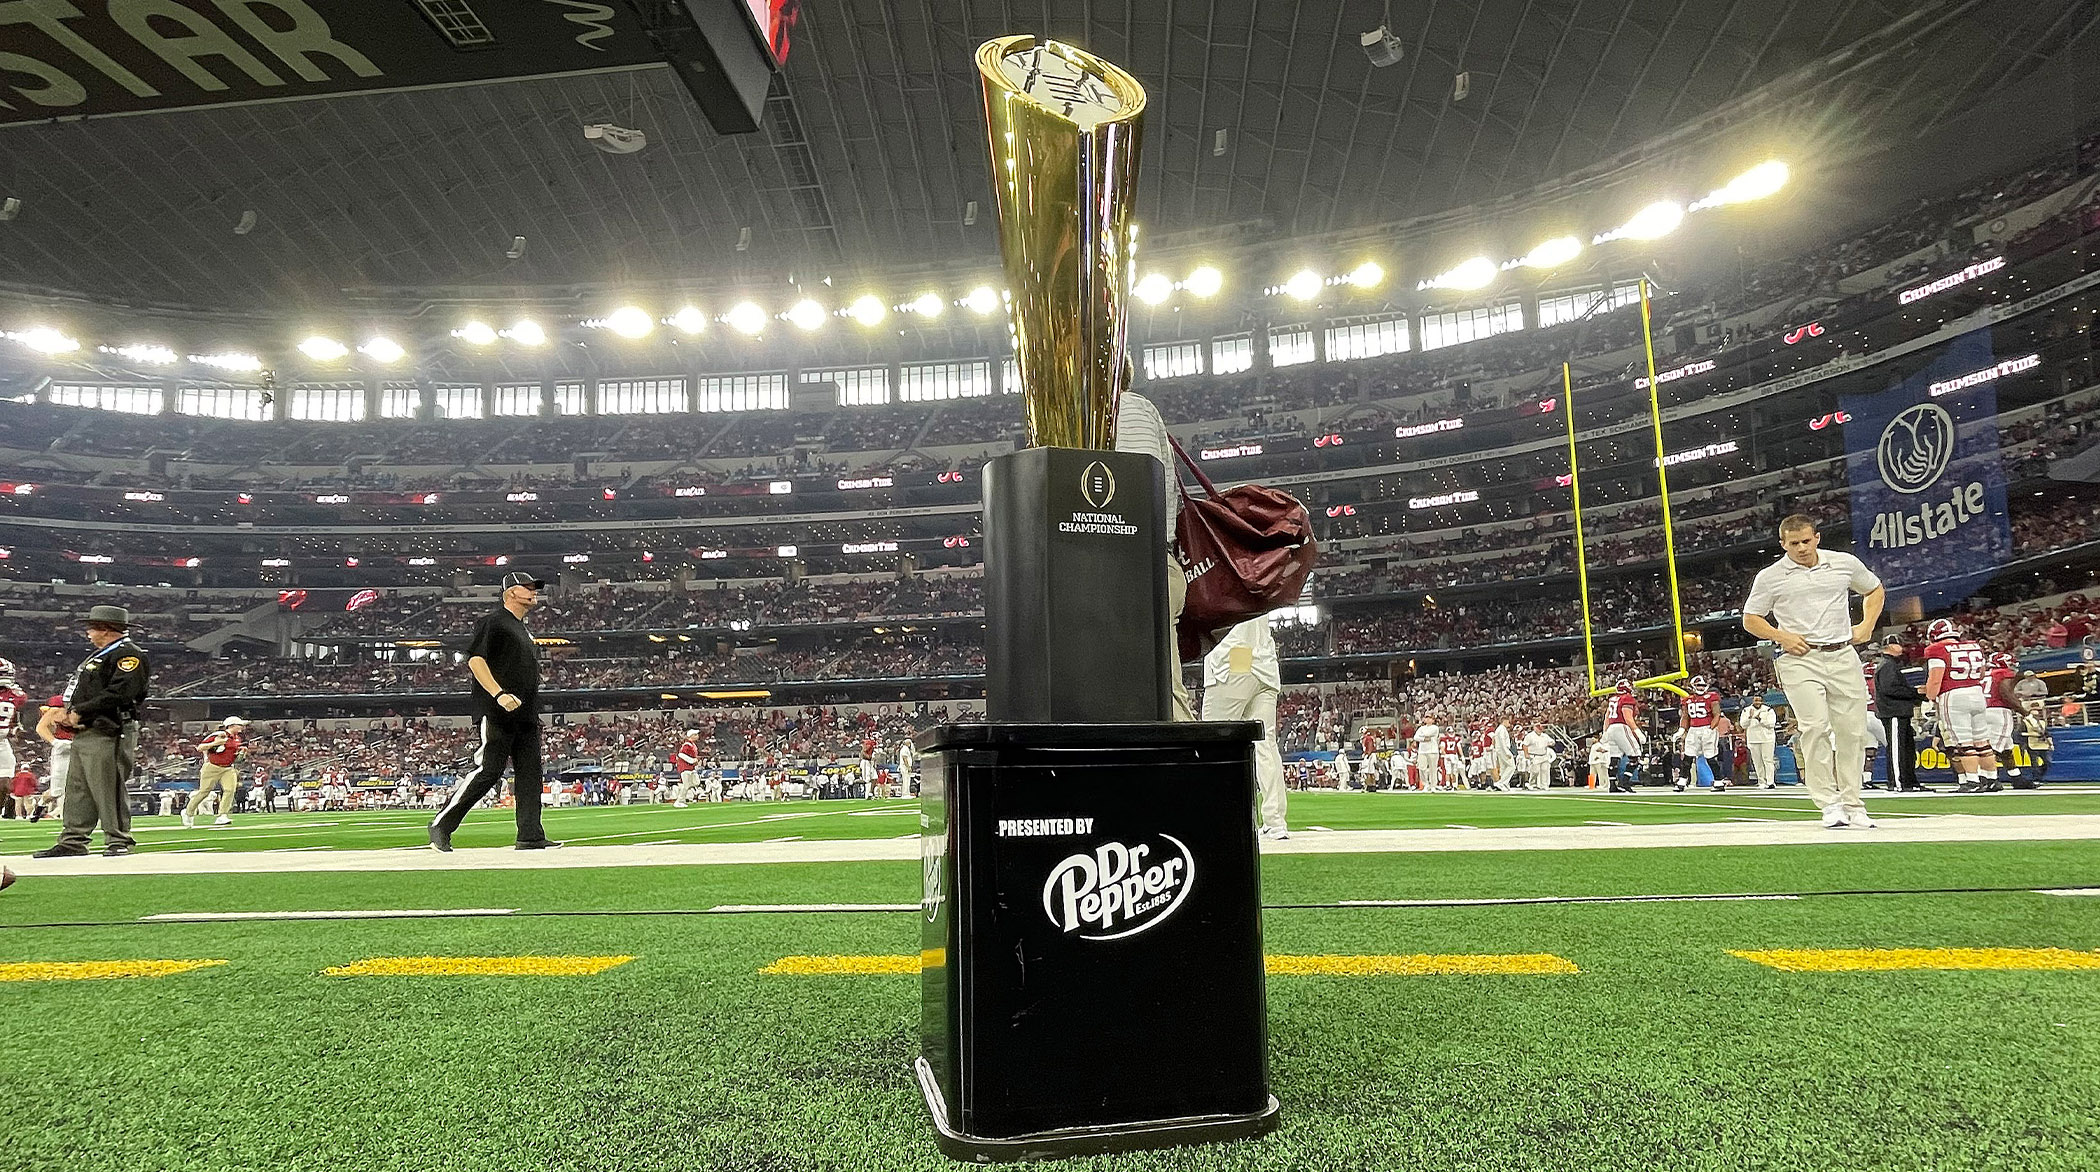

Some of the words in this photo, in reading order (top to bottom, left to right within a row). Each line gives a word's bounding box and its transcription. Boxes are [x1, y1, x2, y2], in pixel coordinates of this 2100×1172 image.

[1899, 272, 1965, 305] CRIMSON
[1964, 256, 2007, 280] TIDE
[1634, 367, 1686, 390] CRMSON
[1684, 359, 1716, 376] TIDE
[1929, 366, 1999, 397] CRIMSON
[1997, 353, 2042, 376] TIDE
[1396, 422, 1438, 439] CRIMSON
[1437, 418, 1464, 431] TIDE
[1200, 448, 1240, 460] CRIMSON
[1239, 445, 1264, 456] TIDE
[1706, 441, 1739, 456] TIDE
[1408, 494, 1454, 510] CRIMSON
[1452, 490, 1480, 503] TIDE
[1072, 512, 1125, 525] NATIONAL
[1869, 481, 1985, 549] Allstate
[1058, 522, 1138, 535] CHAMPIONSHIP
[357, 779, 395, 787] GOODYEAR
[999, 818, 1074, 837] PRESENTED
[1075, 818, 1094, 835] BY
[1095, 841, 1150, 889] Dr
[1043, 853, 1184, 933] Pepper
